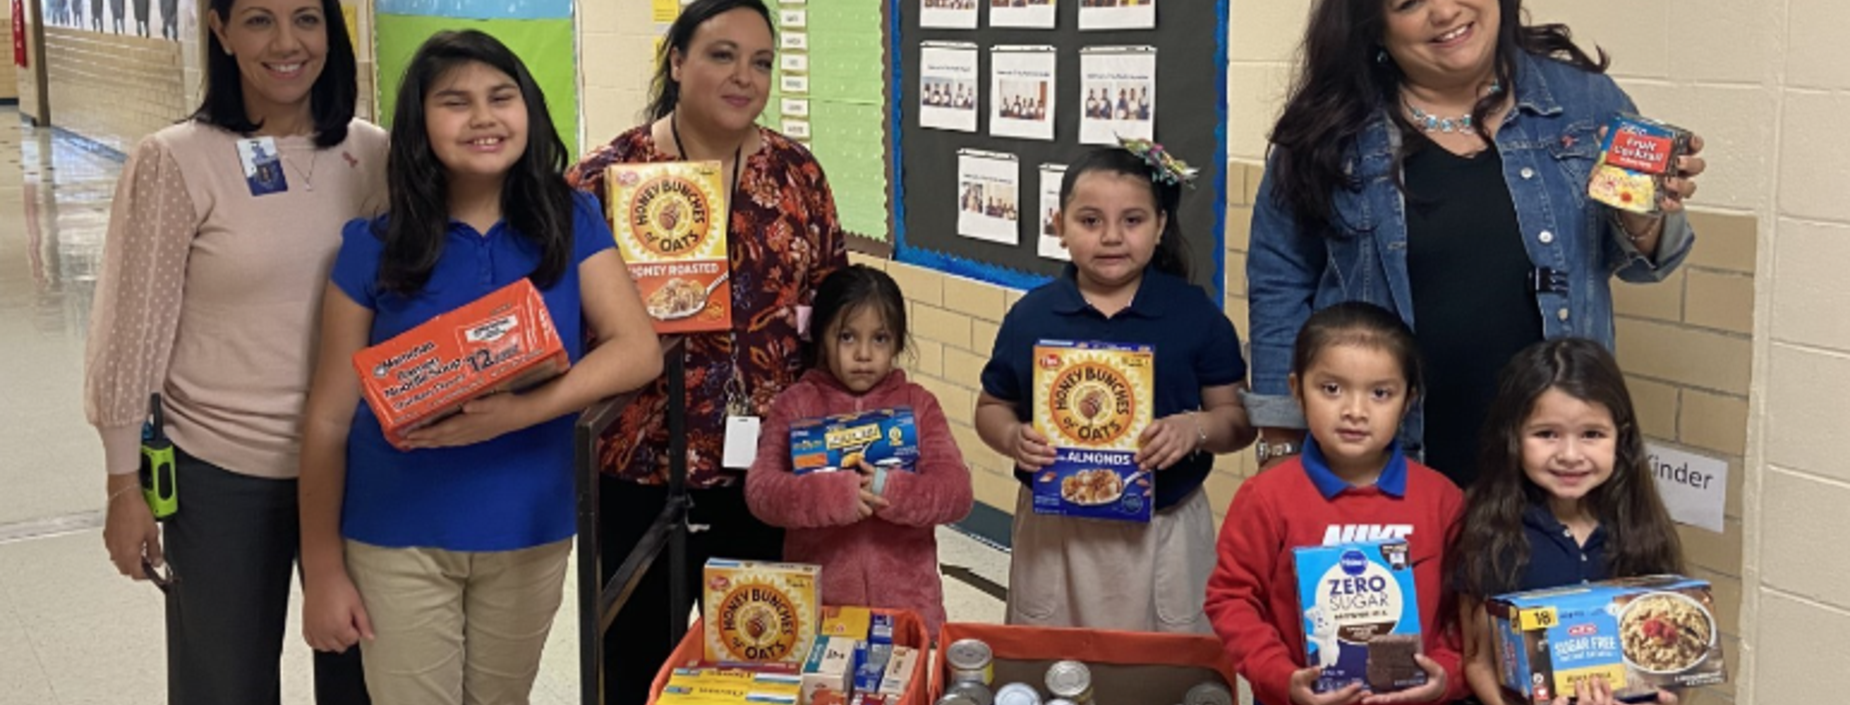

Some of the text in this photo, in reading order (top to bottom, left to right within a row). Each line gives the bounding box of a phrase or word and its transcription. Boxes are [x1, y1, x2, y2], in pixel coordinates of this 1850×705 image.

[1614, 145, 1664, 162] Cocktail
[1626, 138, 1657, 152] Fruit
[635, 180, 706, 226] HONEY BUNCHES
[659, 229, 699, 252] OATS
[668, 262, 720, 276] ROASTED
[382, 340, 436, 369] Maruchan
[465, 348, 495, 372] 12
[1055, 366, 1129, 415] HONEY BUNCHES
[1077, 420, 1121, 440] OATS
[1067, 450, 1131, 465] ALMONDS
[1328, 575, 1386, 596] ZERO
[723, 587, 793, 635] HONEY BUNCHES
[1329, 593, 1390, 612] SUGAR
[1533, 610, 1552, 626] 18
[744, 640, 786, 661] OATS
[1554, 636, 1617, 653] SUGAR FREE
